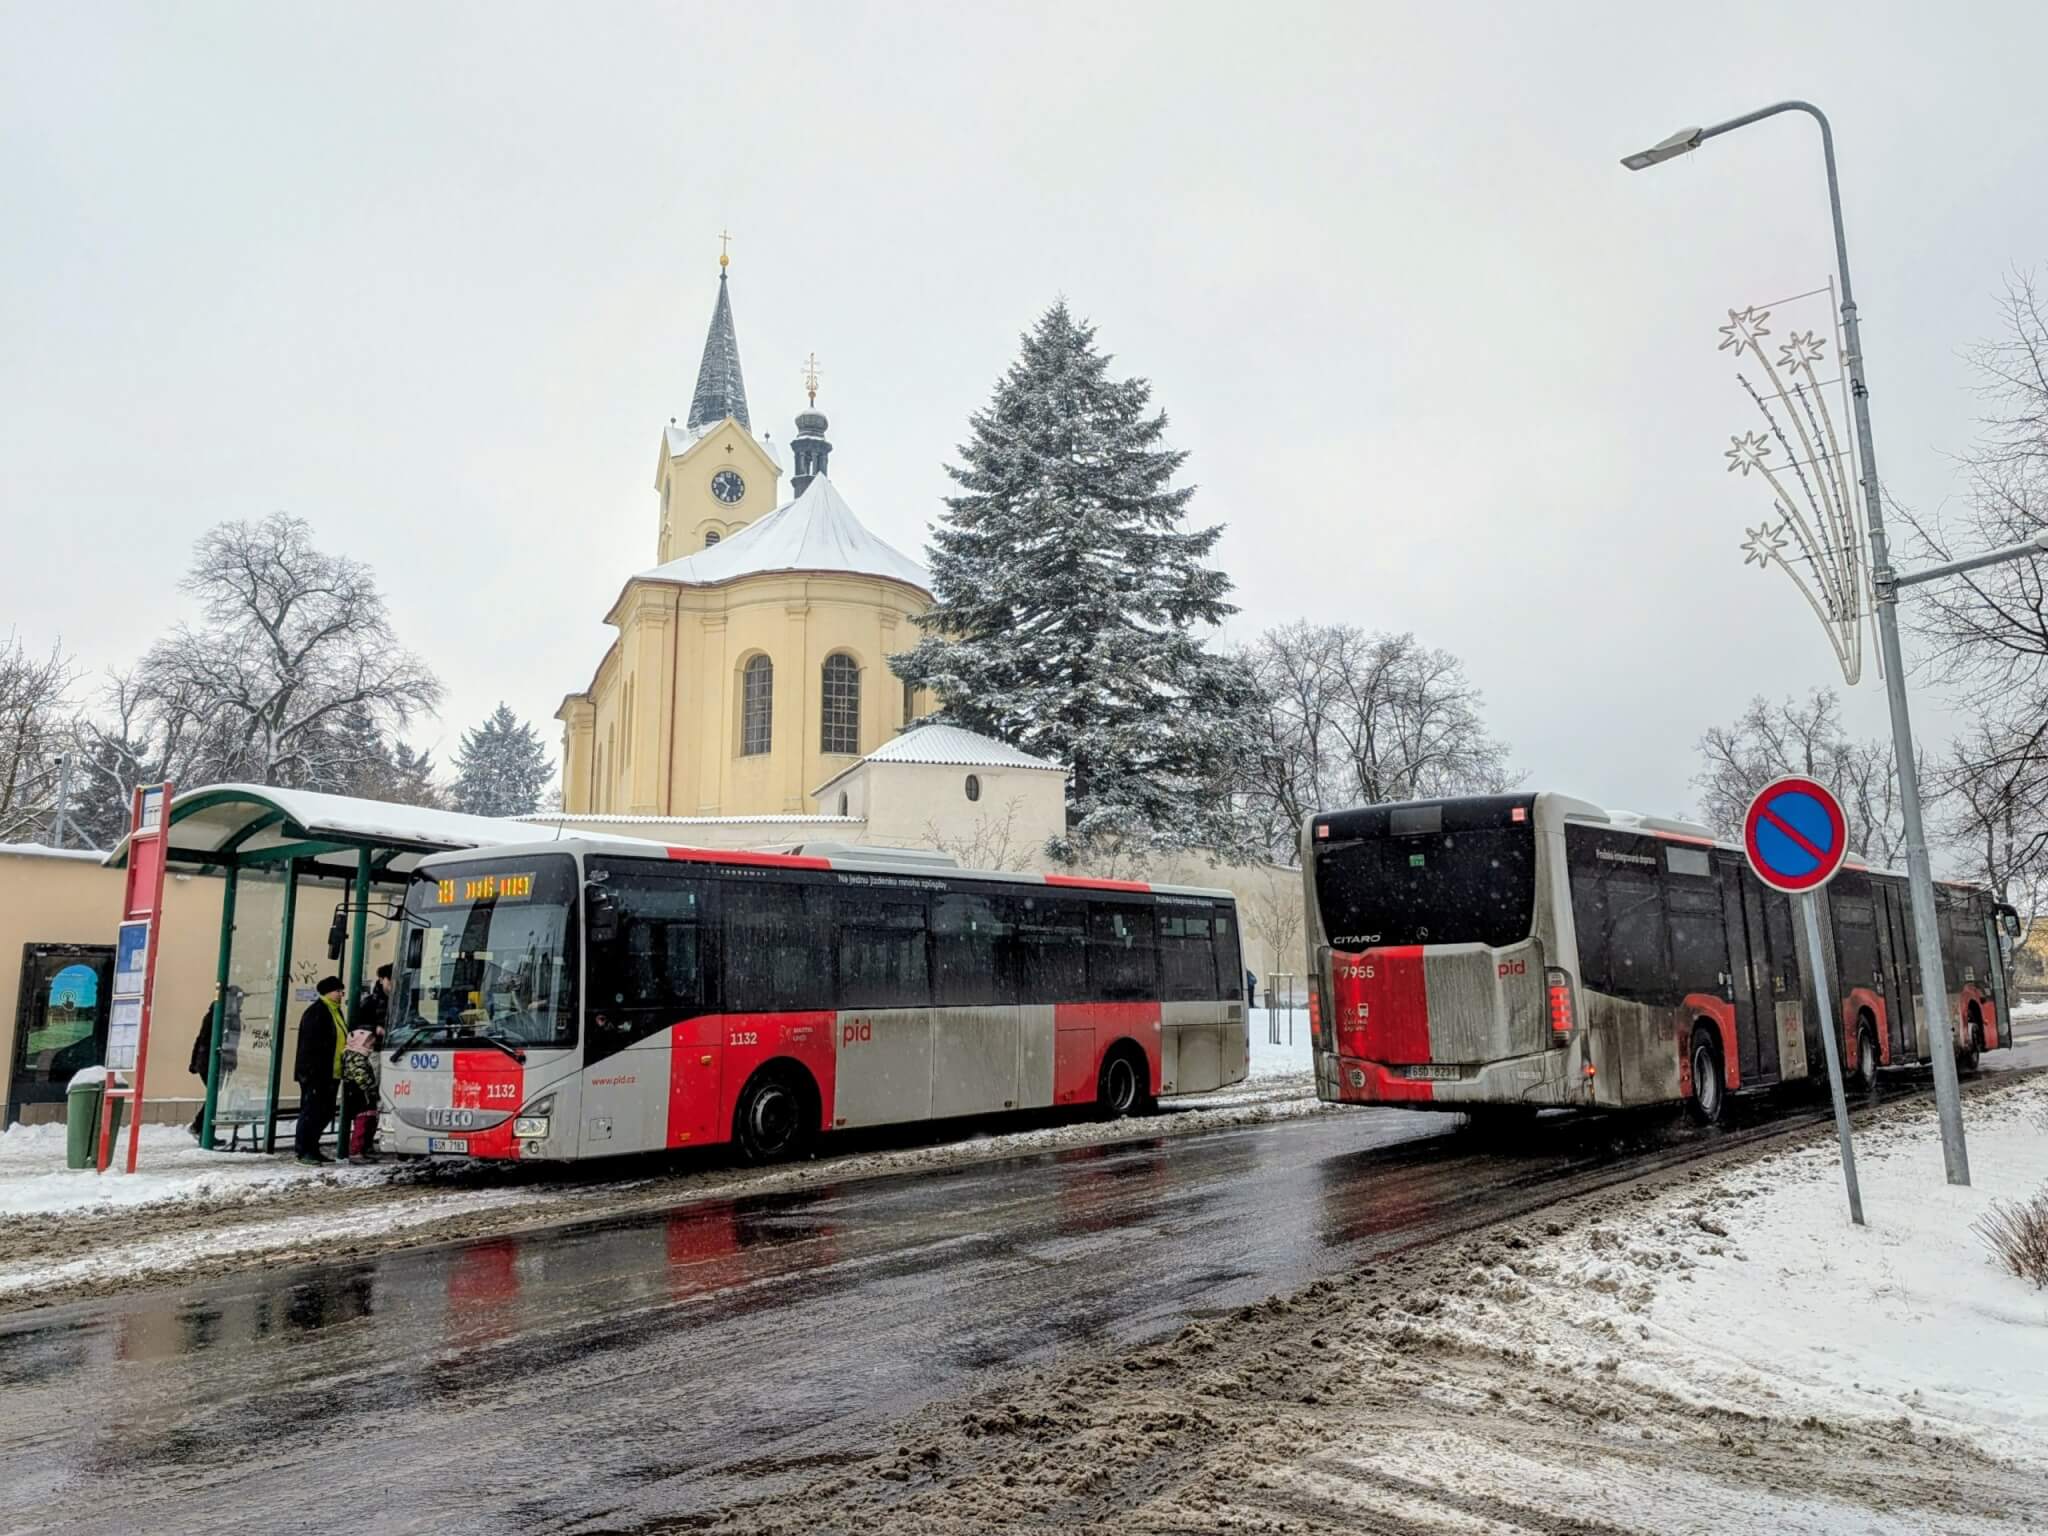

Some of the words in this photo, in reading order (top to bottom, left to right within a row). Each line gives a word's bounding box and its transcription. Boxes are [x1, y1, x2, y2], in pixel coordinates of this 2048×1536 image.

[1333, 934, 1381, 945] CITARO
[1341, 965, 1375, 979] 7955
[1498, 959, 1526, 980] pid
[729, 1032, 758, 1046] 1132
[843, 1019, 871, 1048] pid
[591, 1075, 636, 1087] www.pid.cz
[394, 1081, 411, 1098] pid
[487, 1084, 516, 1098] 1132
[425, 1108, 474, 1126] IVECO
